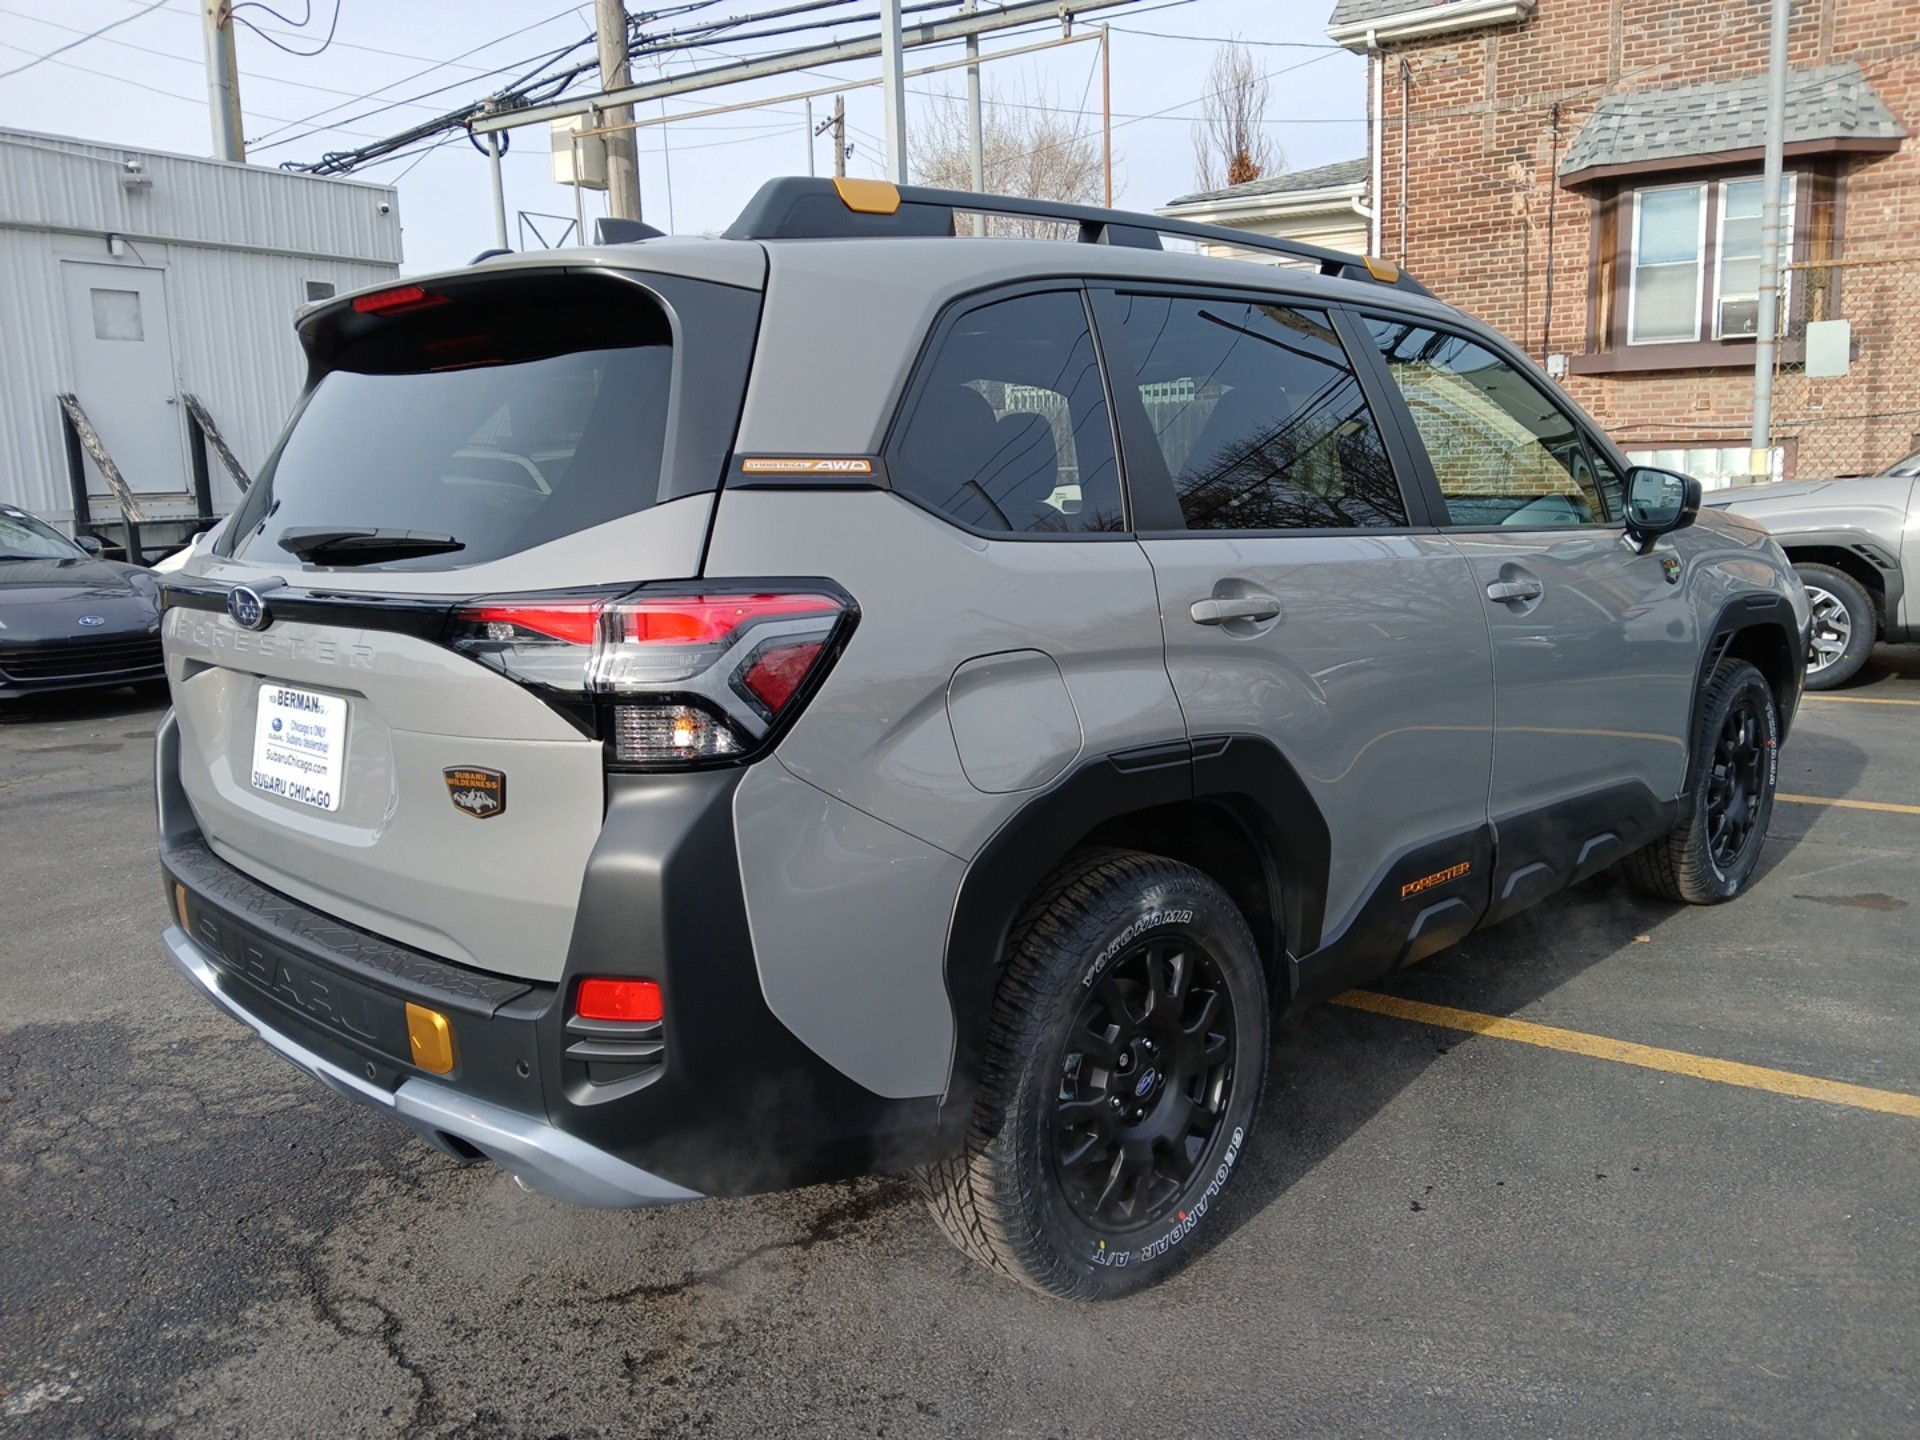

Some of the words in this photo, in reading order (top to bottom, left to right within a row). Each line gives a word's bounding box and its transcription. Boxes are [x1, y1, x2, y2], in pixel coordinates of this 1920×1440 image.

[815, 460, 868, 470] AWD
[175, 618, 375, 669] FORESTER
[277, 690, 319, 714] BERMAN
[286, 732, 303, 747] Subaru
[290, 720, 313, 737] Chicago's
[314, 725, 327, 739] ONLY
[265, 748, 328, 775] SubaruChicago.com
[447, 779, 498, 789] WILDERNESS
[454, 771, 487, 781] SUBARU
[253, 771, 286, 795] SUBARU
[288, 781, 331, 809] CHICAGO
[1401, 861, 1471, 898] FORESTER
[1082, 909, 1193, 988] YOKOHAMA
[198, 915, 378, 1040] SUBARU
[1141, 1126, 1244, 1262] GEOLANDAR
[1092, 1249, 1130, 1267] A/T
